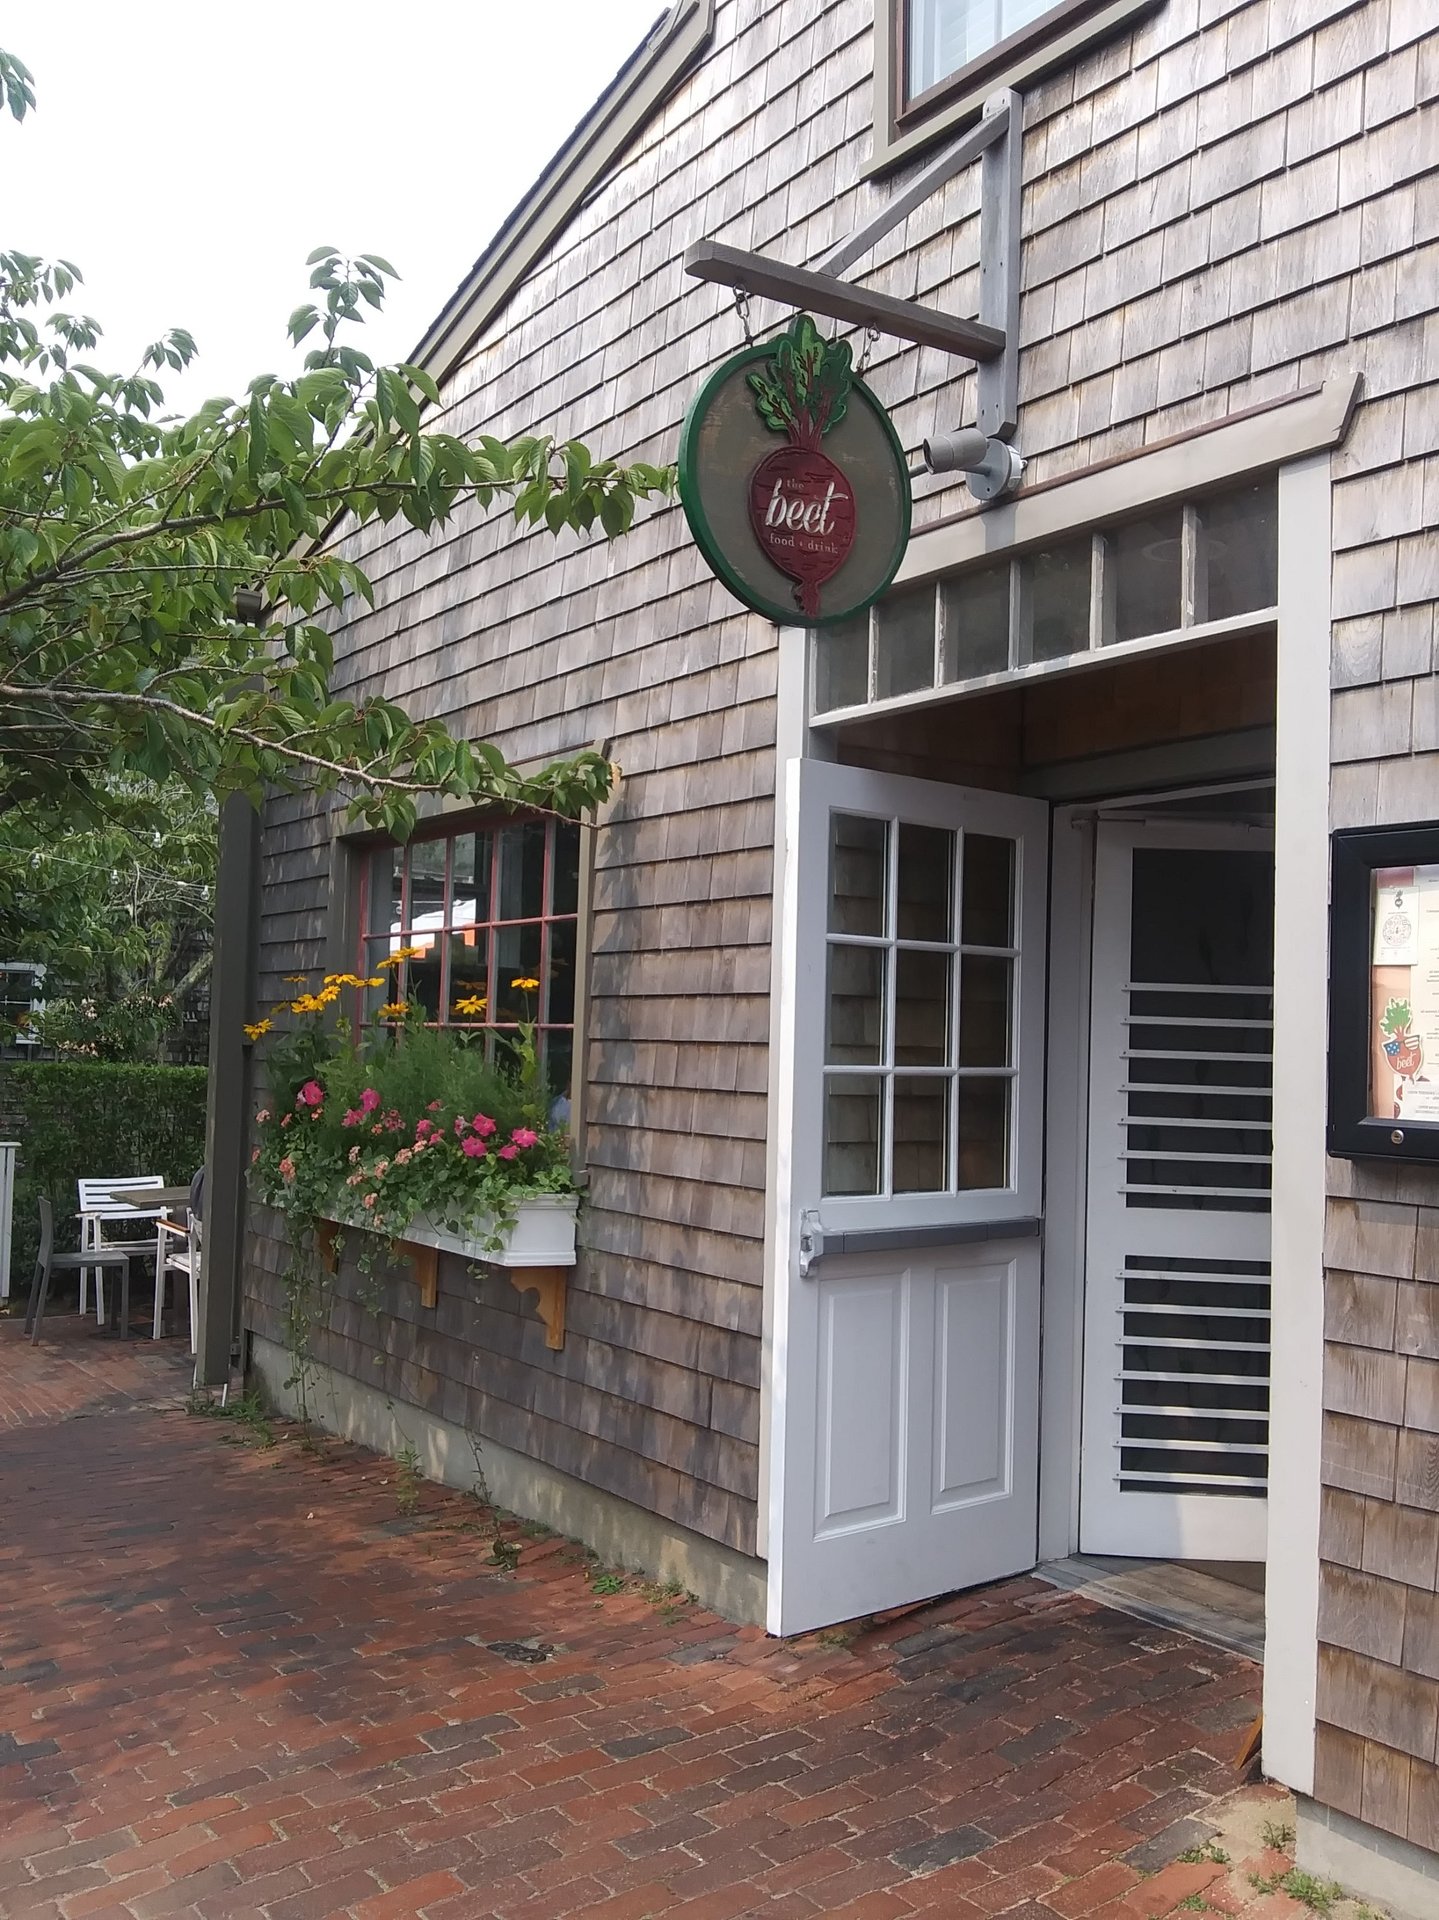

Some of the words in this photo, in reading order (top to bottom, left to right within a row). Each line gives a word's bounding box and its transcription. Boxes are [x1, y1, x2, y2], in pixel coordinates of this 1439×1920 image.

[787, 478, 804, 489] the
[765, 477, 848, 535] beet
[769, 532, 795, 547] food
[807, 540, 838, 553] drink
[1396, 1052, 1417, 1070] beet
